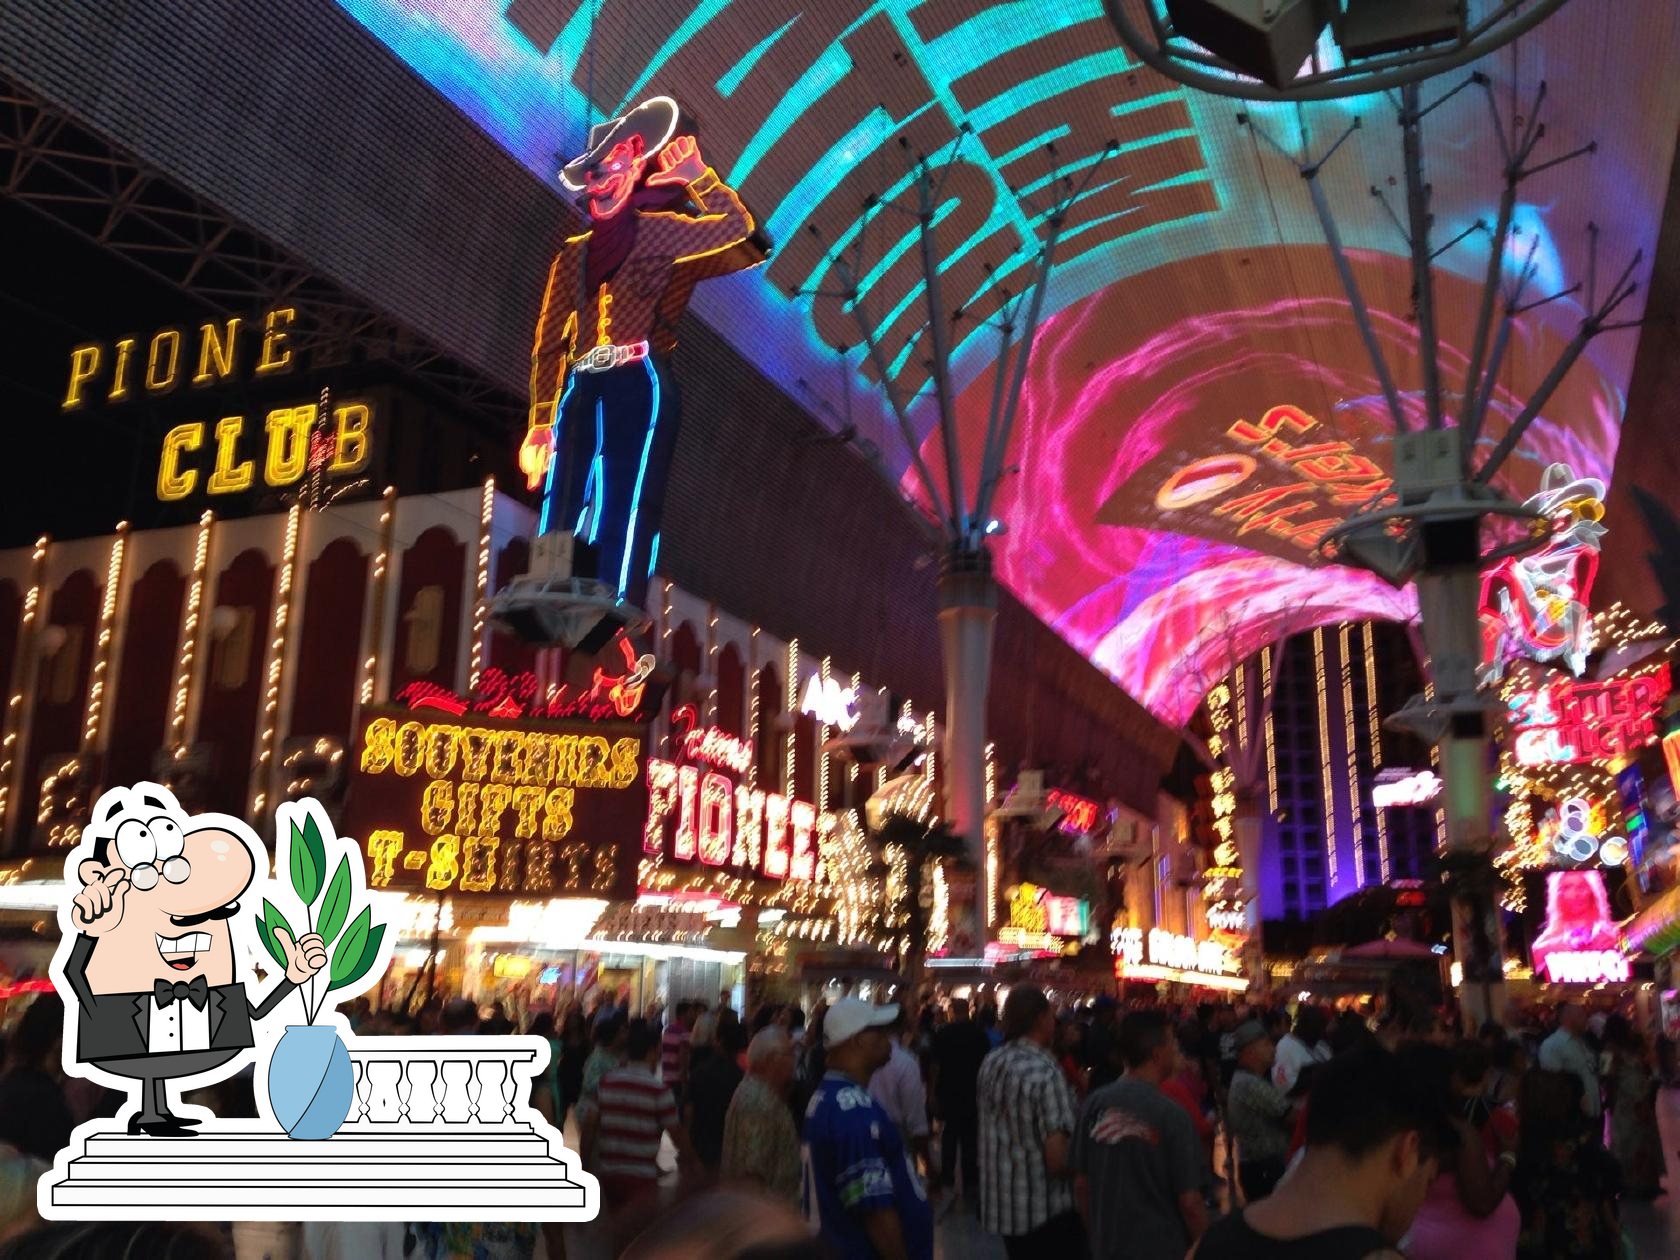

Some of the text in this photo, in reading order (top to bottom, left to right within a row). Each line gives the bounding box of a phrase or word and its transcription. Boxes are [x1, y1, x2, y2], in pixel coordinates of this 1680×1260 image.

[62, 307, 296, 408] PIONE
[157, 403, 375, 501] CLUB
[361, 717, 641, 789] SOUVENIRS
[420, 779, 575, 842] GIFTS
